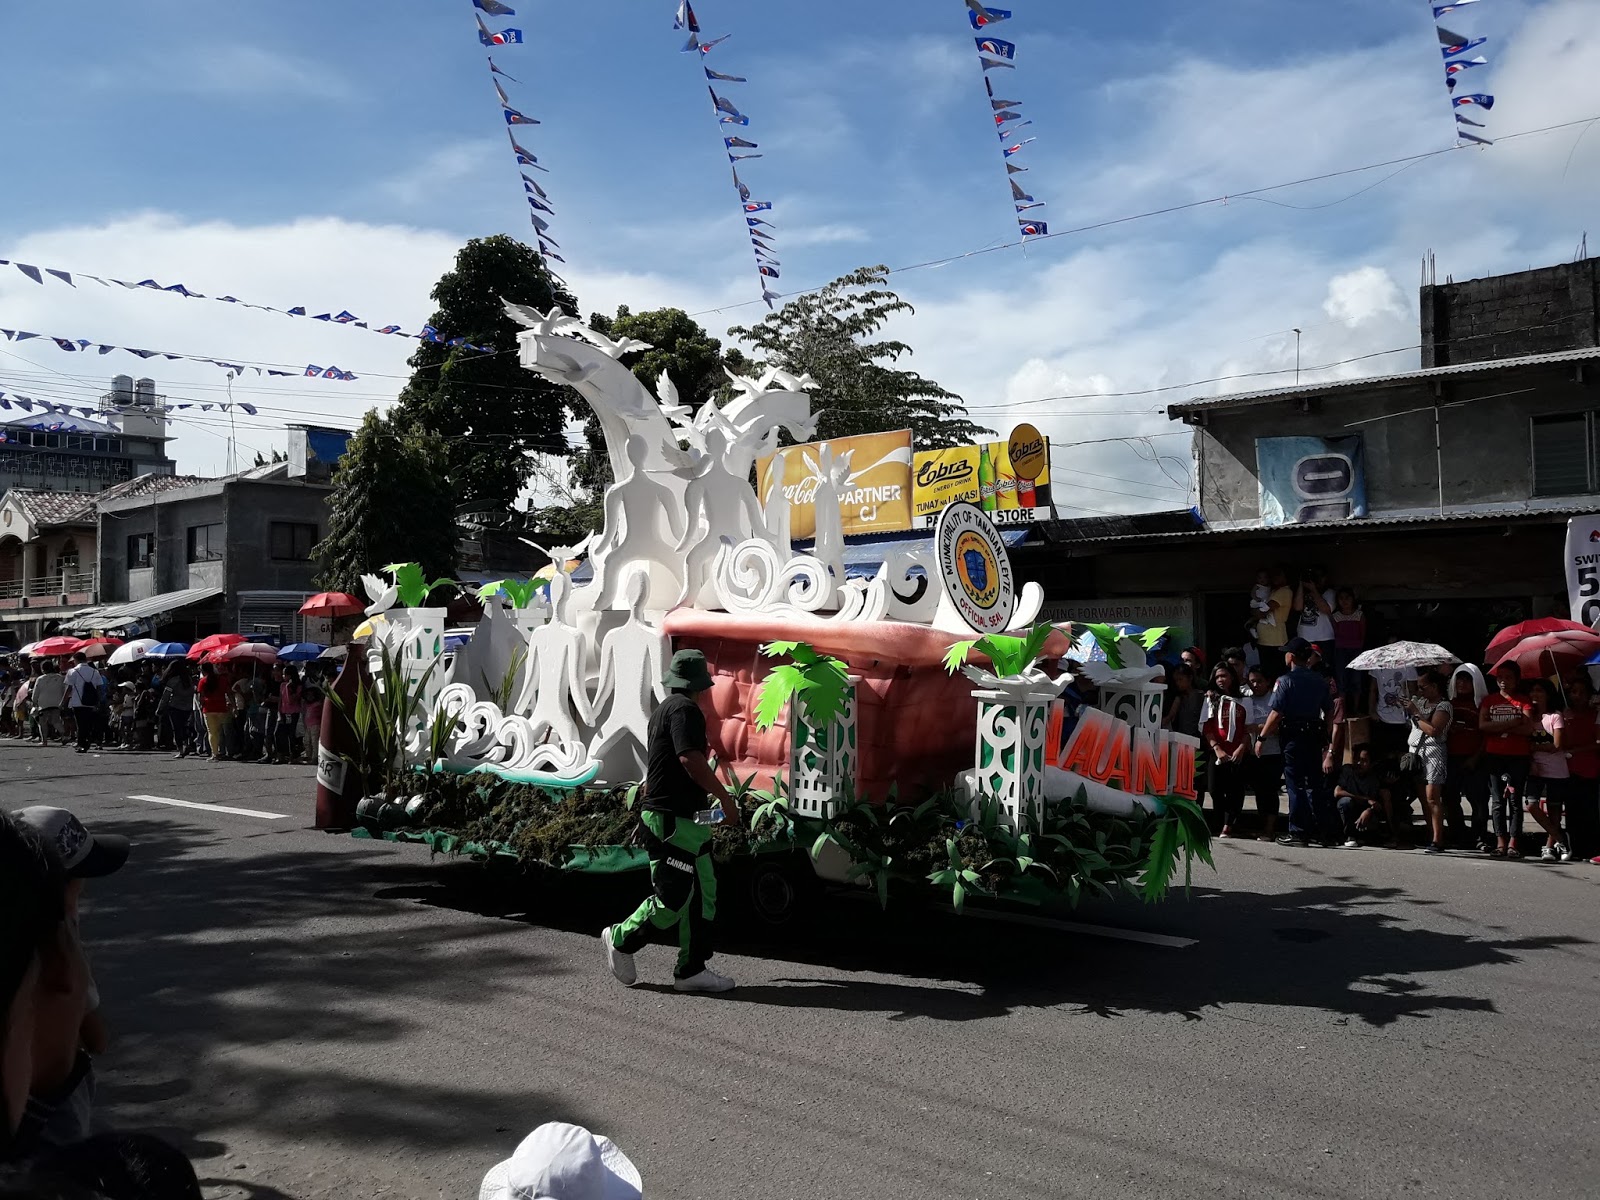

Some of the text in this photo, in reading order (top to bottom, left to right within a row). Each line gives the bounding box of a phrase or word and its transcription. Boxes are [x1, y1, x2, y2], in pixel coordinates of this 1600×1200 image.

[1010, 438, 1044, 462] Cobra
[917, 459, 973, 487] Cobra
[933, 477, 972, 493] ENERGY DRINK
[860, 506, 877, 522] CJ
[916, 499, 939, 513] TUNAY
[997, 509, 1035, 523] STORE
[945, 511, 963, 575] MUNICIPALITY
[962, 510, 972, 524] OF
[999, 559, 1011, 595] LEYTE
[1574, 554, 1600, 566] SWI
[960, 597, 1004, 628] OFFICIAL SEAL
[1040, 606, 1187, 620] OVING FORWARD TANAUAN
